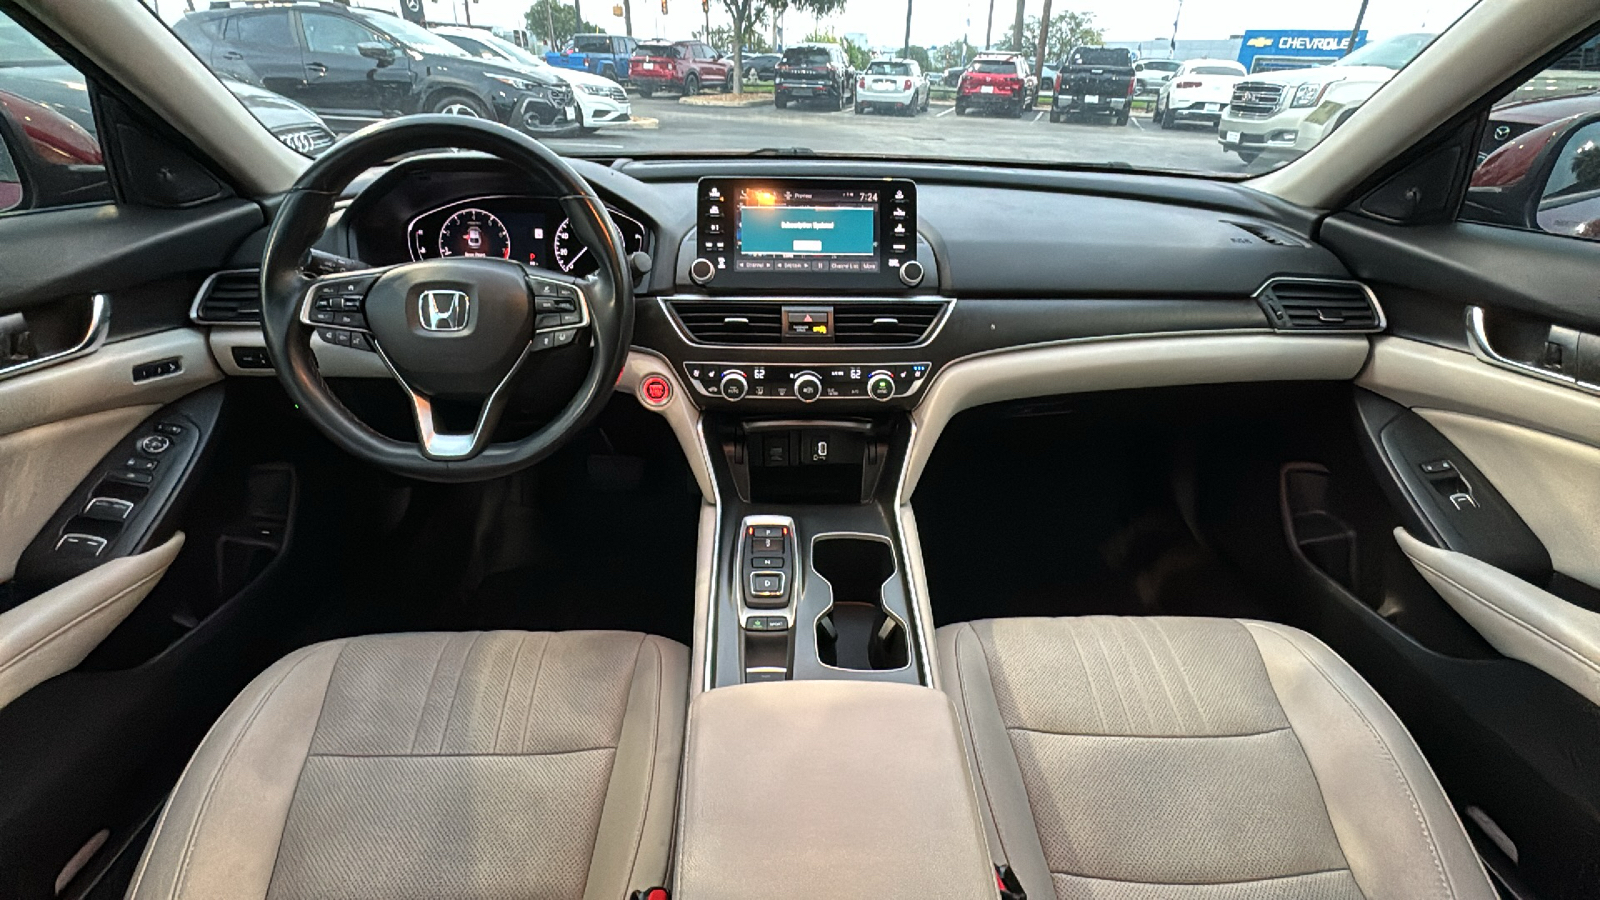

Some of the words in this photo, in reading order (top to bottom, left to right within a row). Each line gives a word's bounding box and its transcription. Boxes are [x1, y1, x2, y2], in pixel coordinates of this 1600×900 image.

[1279, 37, 1358, 50] CHEVROLE
[859, 192, 878, 202] 7:24
[560, 247, 568, 256] 20
[754, 369, 766, 379] 62
[850, 369, 861, 379] 62
[764, 579, 771, 587] D
